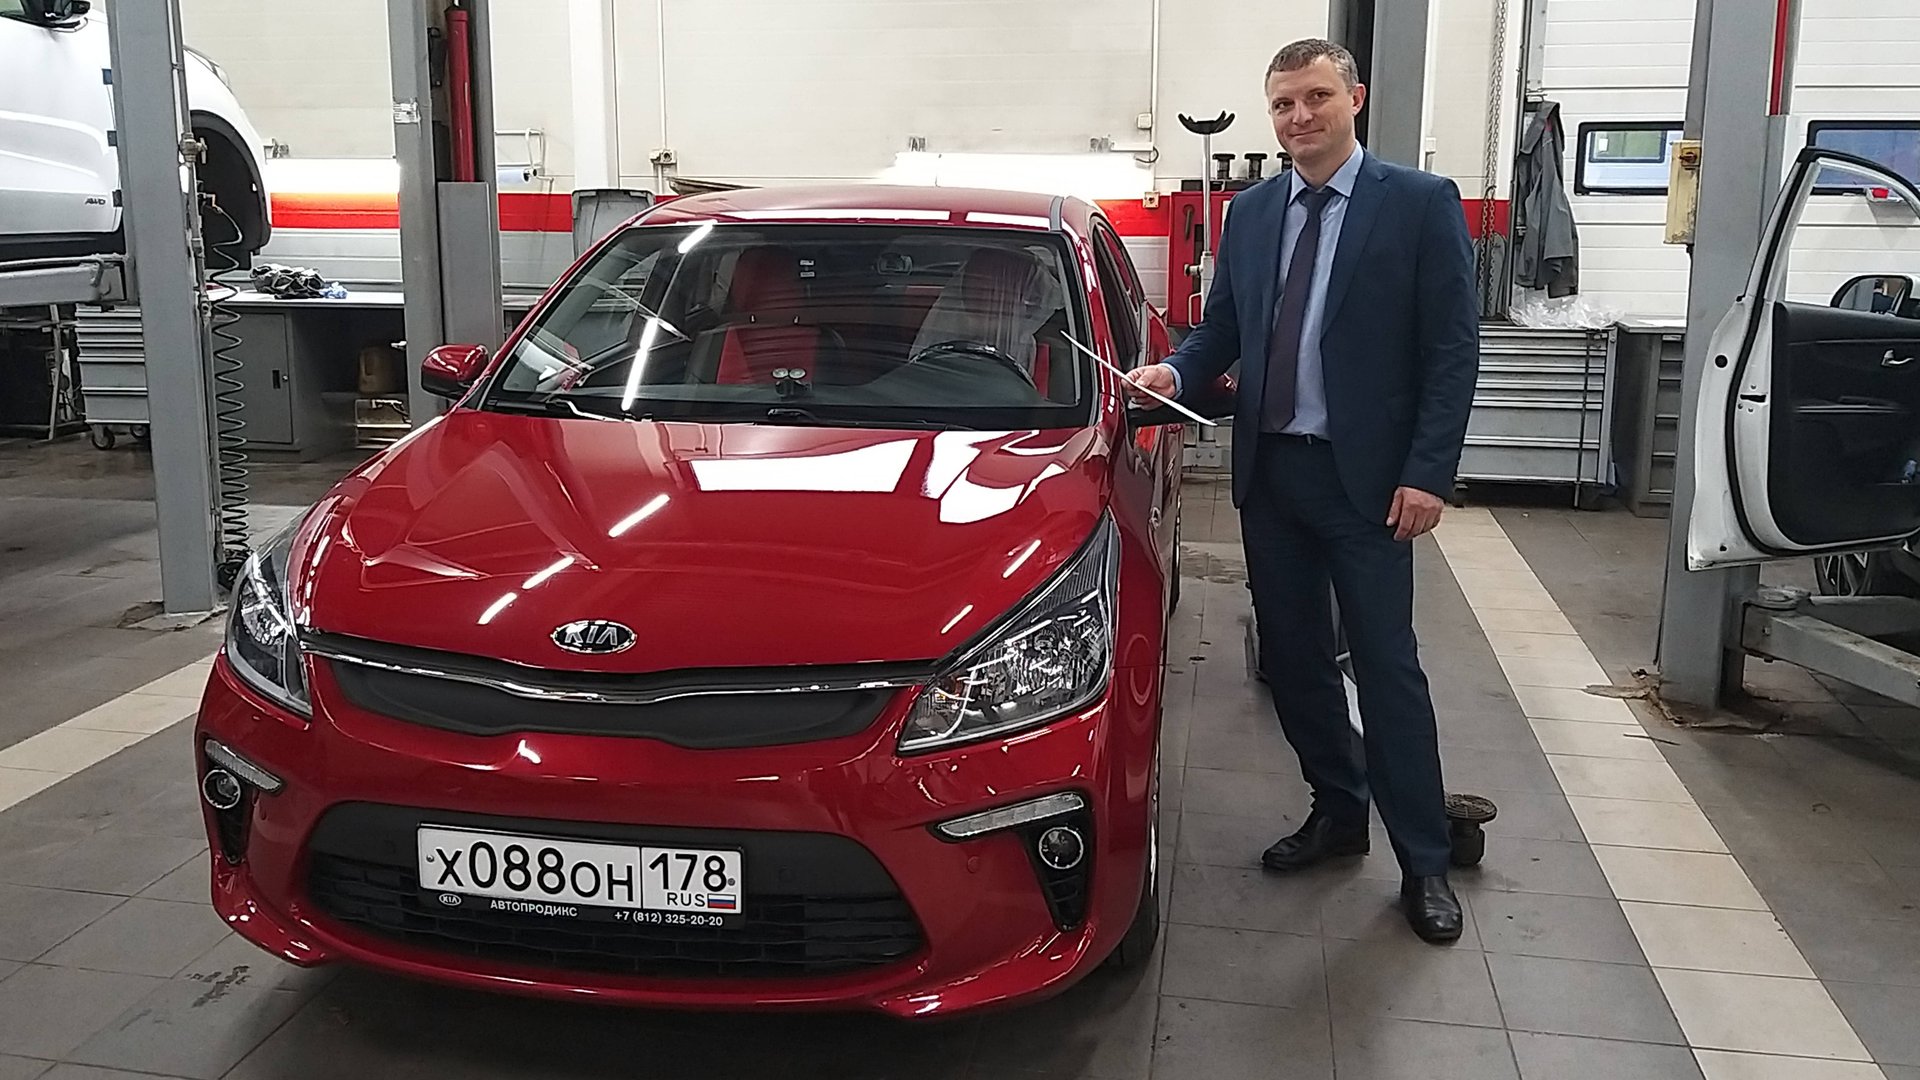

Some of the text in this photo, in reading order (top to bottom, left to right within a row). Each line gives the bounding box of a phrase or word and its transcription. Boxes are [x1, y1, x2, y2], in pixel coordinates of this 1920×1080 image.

[564, 624, 618, 646] KIA
[648, 852, 728, 892] 178
[667, 892, 706, 907] RUS
[490, 900, 578, 917] АВТОПРОДИКС
[614, 911, 723, 926] +7 (812) 325-20-20
